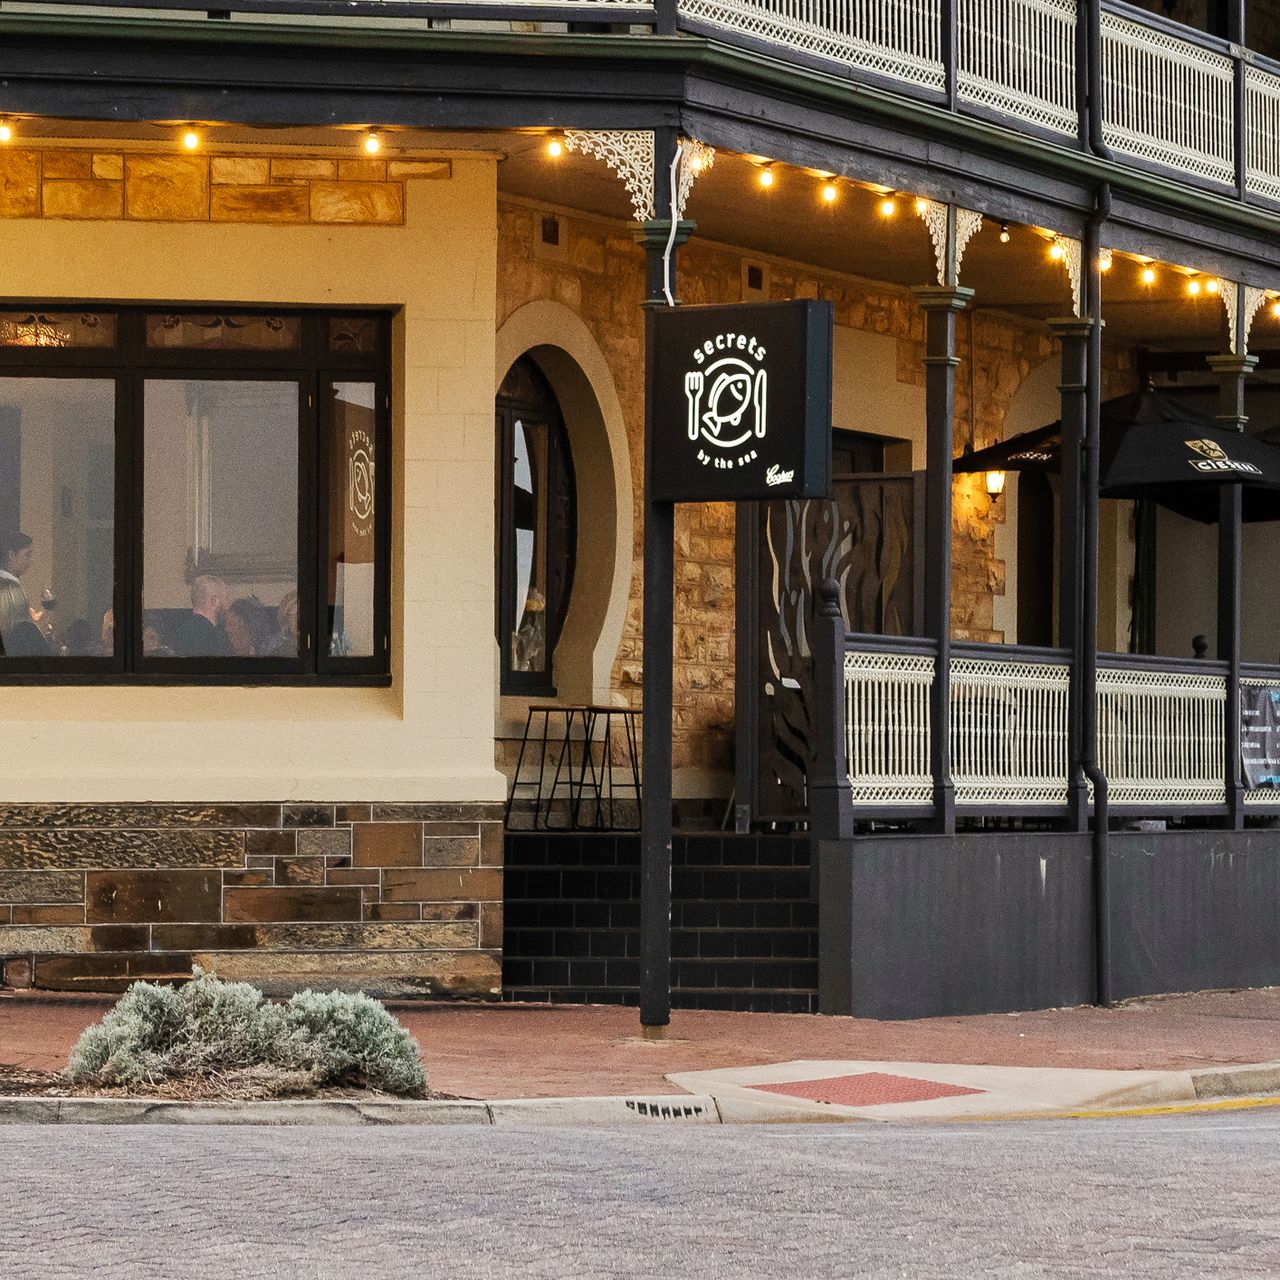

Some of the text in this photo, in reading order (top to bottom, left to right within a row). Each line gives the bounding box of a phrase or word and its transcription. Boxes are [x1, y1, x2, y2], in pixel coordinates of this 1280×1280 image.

[693, 333, 767, 364] secrets
[697, 449, 758, 469] by the sea
